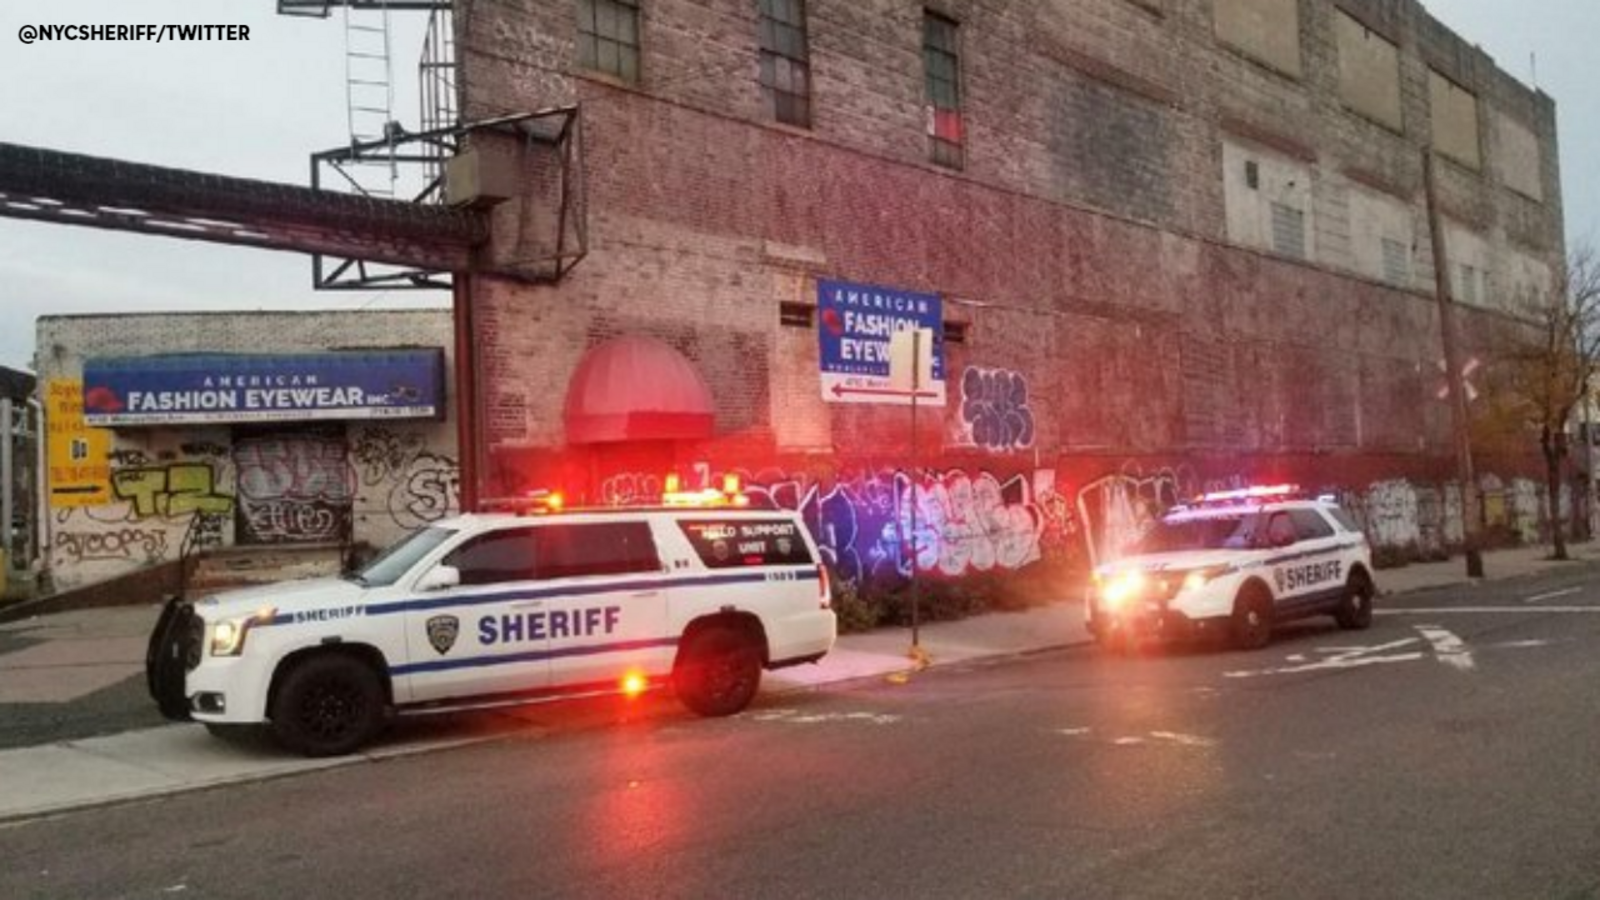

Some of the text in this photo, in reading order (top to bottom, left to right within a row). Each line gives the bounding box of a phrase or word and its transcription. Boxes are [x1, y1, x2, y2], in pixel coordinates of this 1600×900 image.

[834, 289, 929, 313] AMERICAN
[203, 375, 319, 388] AMERICAN
[127, 389, 237, 411] FASHION
[245, 387, 364, 408] EYEWEAR
[740, 523, 794, 536] SUPPORT
[738, 540, 767, 553] UNIT
[1286, 560, 1342, 590] SHERIFF
[296, 605, 364, 623] SHERIFF
[478, 606, 620, 645] SHERIFF
